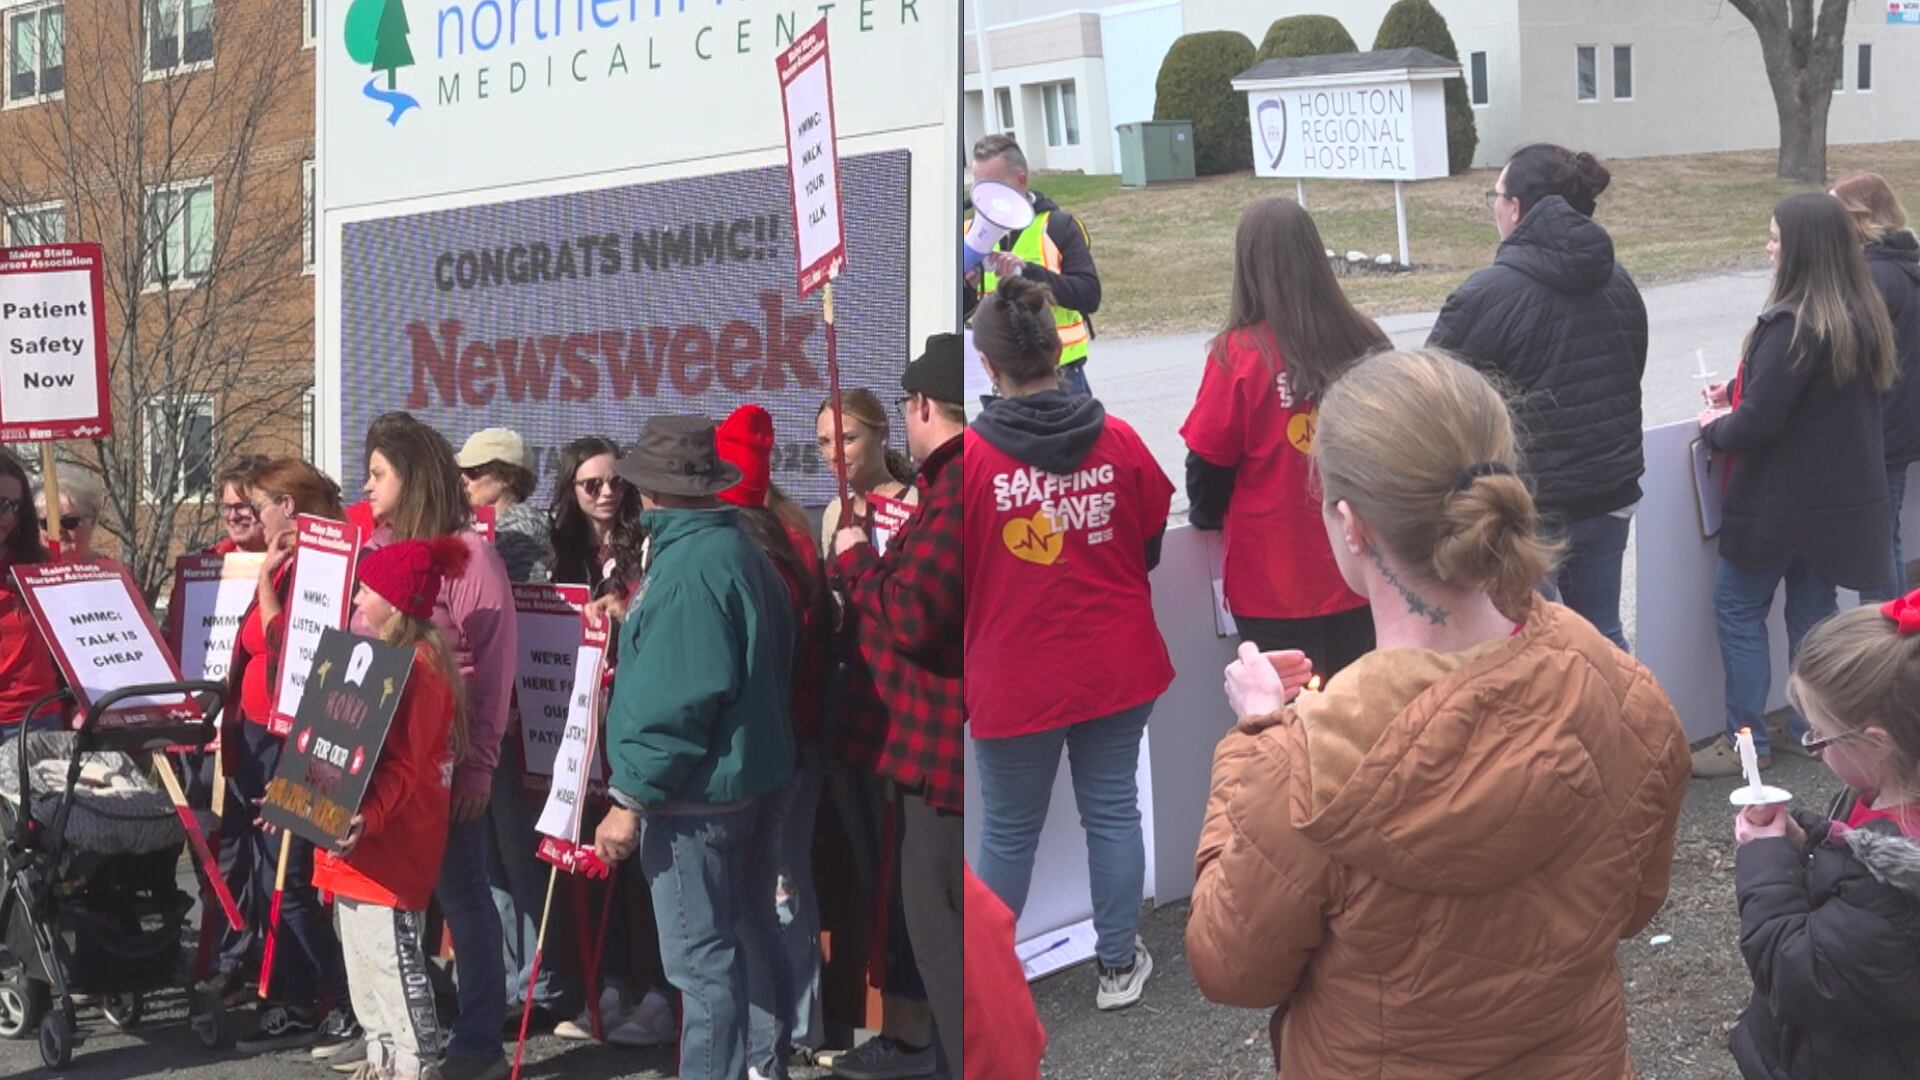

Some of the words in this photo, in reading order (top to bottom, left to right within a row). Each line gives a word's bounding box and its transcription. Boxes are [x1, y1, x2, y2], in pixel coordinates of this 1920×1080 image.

[438, 37, 662, 106] MEDICAL
[695, 0, 920, 60] CENTER
[1299, 89, 1405, 117] HOULTON
[1301, 118, 1405, 143] REGIONAL
[1303, 146, 1407, 171] HOSPITAL
[9, 250, 41, 260] Maine
[44, 248, 73, 259] State
[435, 232, 622, 292] CONGRATS
[631, 213, 780, 274] NMMC!!
[0, 260, 28, 270] urses
[30, 256, 93, 269] Association
[3, 300, 87, 319] Patient
[10, 336, 84, 356] Safety
[405, 291, 823, 411] Newsweek
[23, 372, 75, 389] Now
[1040, 491, 1116, 519] SAVES
[1051, 508, 1111, 534] LIVES
[25, 576, 62, 585] Nurses
[64, 571, 122, 582] Association
[40, 565, 72, 576] Maine
[73, 563, 100, 573] State
[69, 610, 123, 626] NMMC:
[293, 616, 321, 633] LISTEN
[76, 631, 120, 647] TALK
[122, 630, 138, 642] IS
[203, 639, 233, 651] WAL
[92, 650, 144, 667] CHEAP
[299, 646, 316, 660] YOU
[530, 649, 572, 666] WE'RE
[203, 663, 230, 676] YOU
[522, 675, 556, 692] HERE
[312, 736, 332, 761] FOR
[329, 744, 349, 769] OUR
